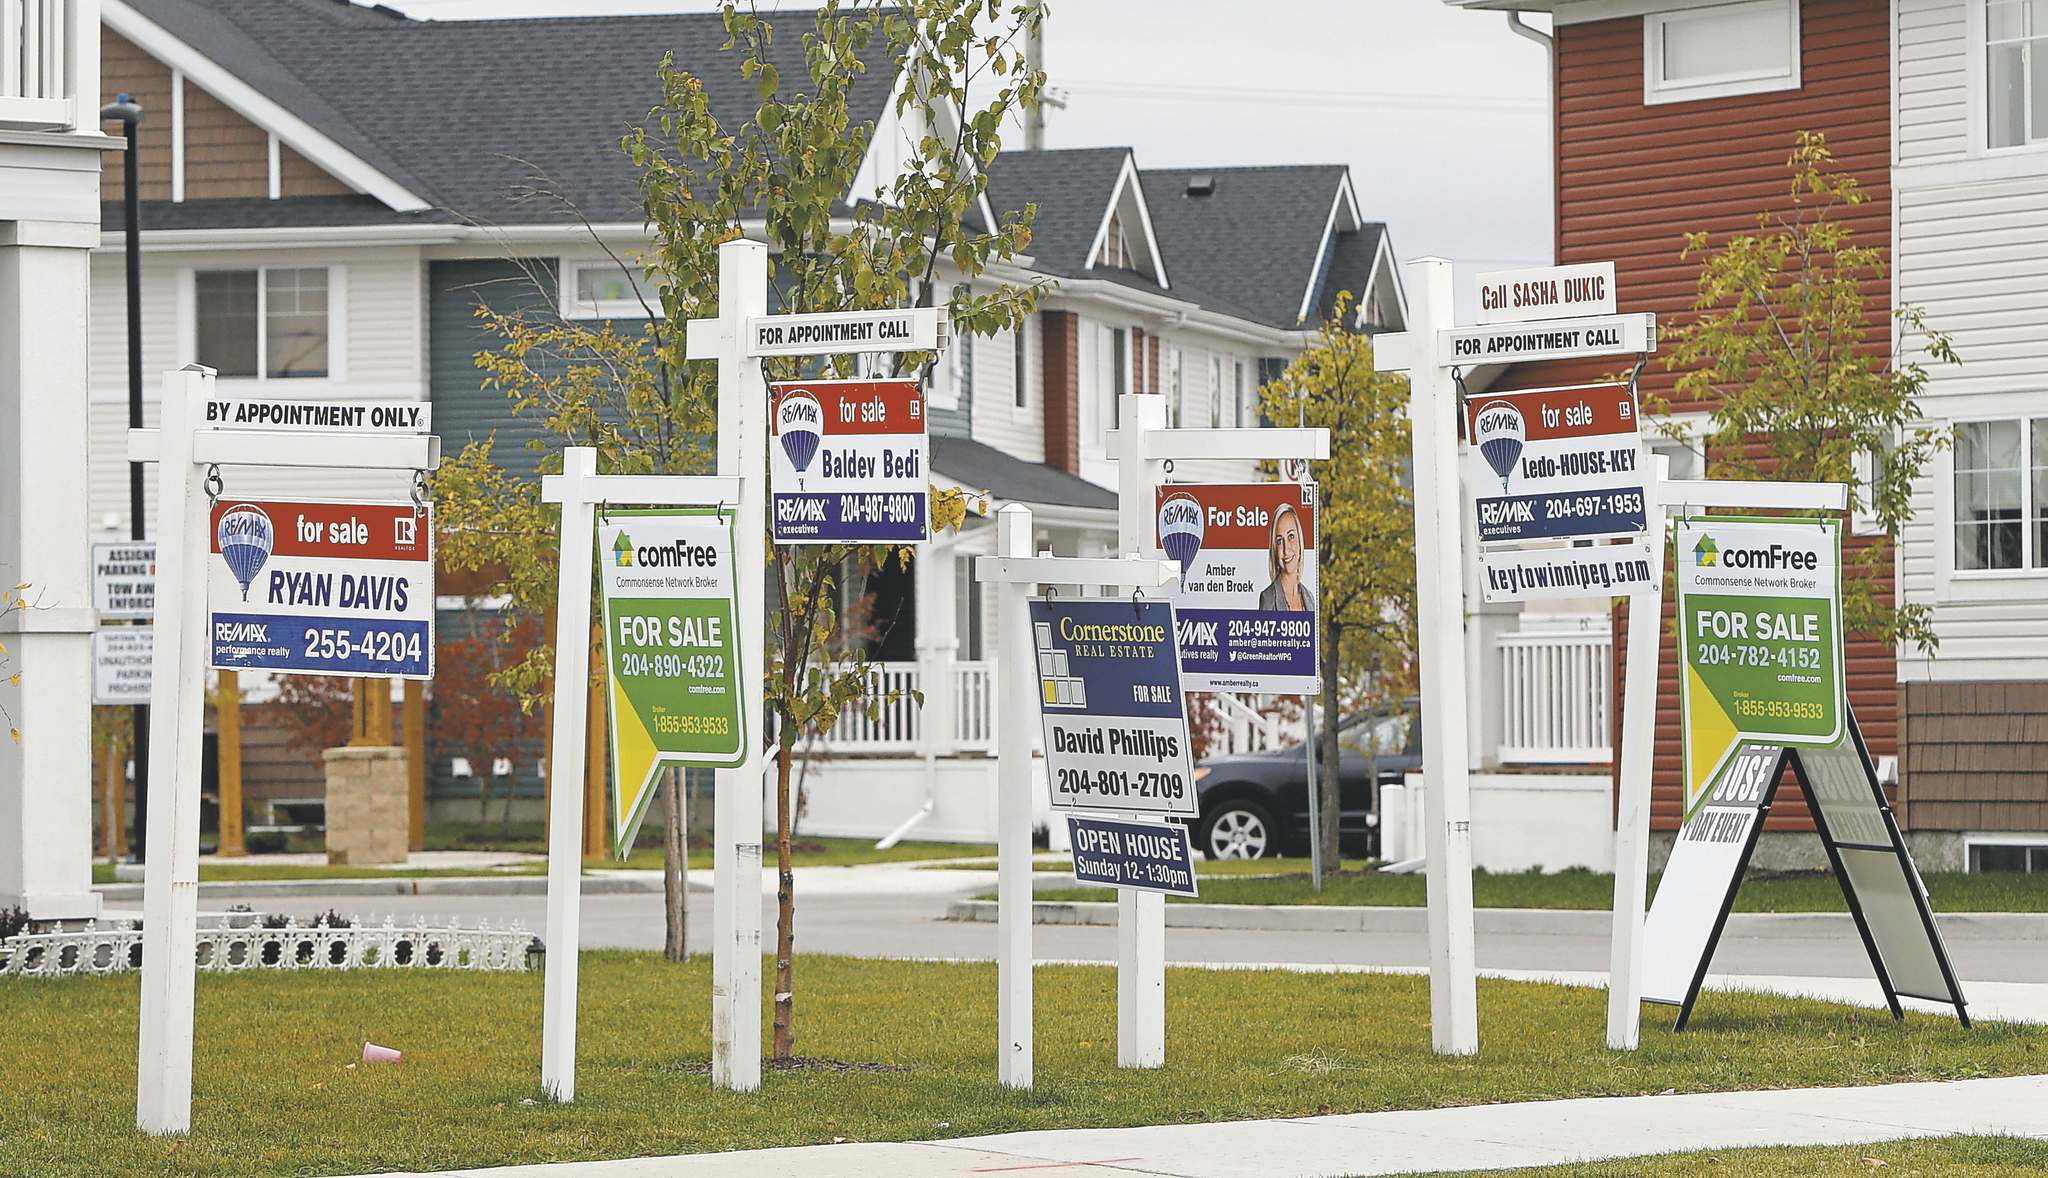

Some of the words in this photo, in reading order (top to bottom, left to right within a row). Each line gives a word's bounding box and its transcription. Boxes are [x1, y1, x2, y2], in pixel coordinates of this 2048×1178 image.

[1482, 285, 1507, 311] Call
[1513, 279, 1558, 308] SASHA
[1565, 276, 1605, 303] DUKIC
[759, 327, 783, 345] FOR
[788, 322, 874, 344] APPOINTMENT
[879, 320, 909, 339] CALL
[1455, 339, 1481, 355] FOR
[1487, 331, 1580, 354] APPOINTMENT
[1585, 328, 1620, 346] CALL
[206, 401, 230, 421] BY
[235, 403, 365, 427] APPOINTMENT
[782, 402, 818, 425] RE/MAX
[839, 396, 856, 423] for
[861, 396, 886, 423] sale
[1480, 411, 1519, 433] RE/MAX
[1542, 404, 1560, 428] for
[1565, 401, 1593, 427] sale
[822, 449, 876, 479] Baldev
[883, 449, 919, 478] Bedi
[1522, 448, 1636, 480] Ledo-HOUSE-KEY
[778, 498, 827, 523] RE/MAX
[841, 494, 915, 524] 204-987-9800
[1164, 505, 1199, 527] RE/MAX
[1208, 506, 1233, 527] For
[1236, 506, 1269, 527] Sale
[1481, 500, 1535, 525] RE/MAX
[1545, 493, 1642, 519] 204-697-1953
[224, 515, 266, 542] RE/MAX
[297, 514, 323, 543] for
[329, 516, 368, 545] sale
[783, 523, 819, 535] executives
[1483, 524, 1521, 536] executives
[638, 540, 717, 568] comFree
[1722, 544, 1817, 571] comFree
[98, 565, 146, 576] PARKING
[616, 576, 664, 588] Commonsense
[665, 577, 694, 588] Network
[695, 577, 718, 589] Broker
[1205, 563, 1235, 577] Amber
[1487, 559, 1651, 594] keytowinnipeg.com
[1695, 573, 1753, 588] Commonsense
[1754, 576, 1788, 589] Network
[1790, 578, 1817, 590] Broker
[107, 583, 133, 594] TOW
[268, 570, 332, 607] RYAN
[339, 574, 409, 612] DAVIS
[1188, 582, 1205, 593] van
[1207, 580, 1224, 593] den
[1226, 580, 1254, 593] Broek
[215, 622, 268, 643] RE/MAX
[619, 616, 663, 648] FOR
[668, 617, 723, 648] SALE
[1060, 616, 1165, 643] Cornerstone
[1228, 620, 1311, 637] 204-947-9800
[1697, 610, 1748, 640] FOR
[1755, 612, 1820, 641] SALE
[215, 644, 266, 656] performance
[268, 645, 290, 659] realty
[304, 628, 422, 662] 255-4204
[1075, 644, 1104, 657] REAL
[1110, 645, 1154, 659] ESTATE
[1200, 649, 1219, 662] realty
[1228, 638, 1311, 649] amber@amberrealty.ca
[688, 684, 726, 694] comfree.com
[1777, 674, 1821, 684] comfree.com
[1133, 684, 1151, 703] FOR
[1152, 685, 1172, 704] SALE
[1053, 726, 1104, 755] David
[1108, 728, 1179, 763] Phillips
[1058, 769, 1183, 800] 204-801-2709
[1711, 812, 1751, 843] EVENT
[1076, 828, 1121, 855] OPEN
[1125, 832, 1182, 862] HOUSE
[1078, 856, 1121, 882] Sunday
[1145, 864, 1189, 888] 1:30pm
